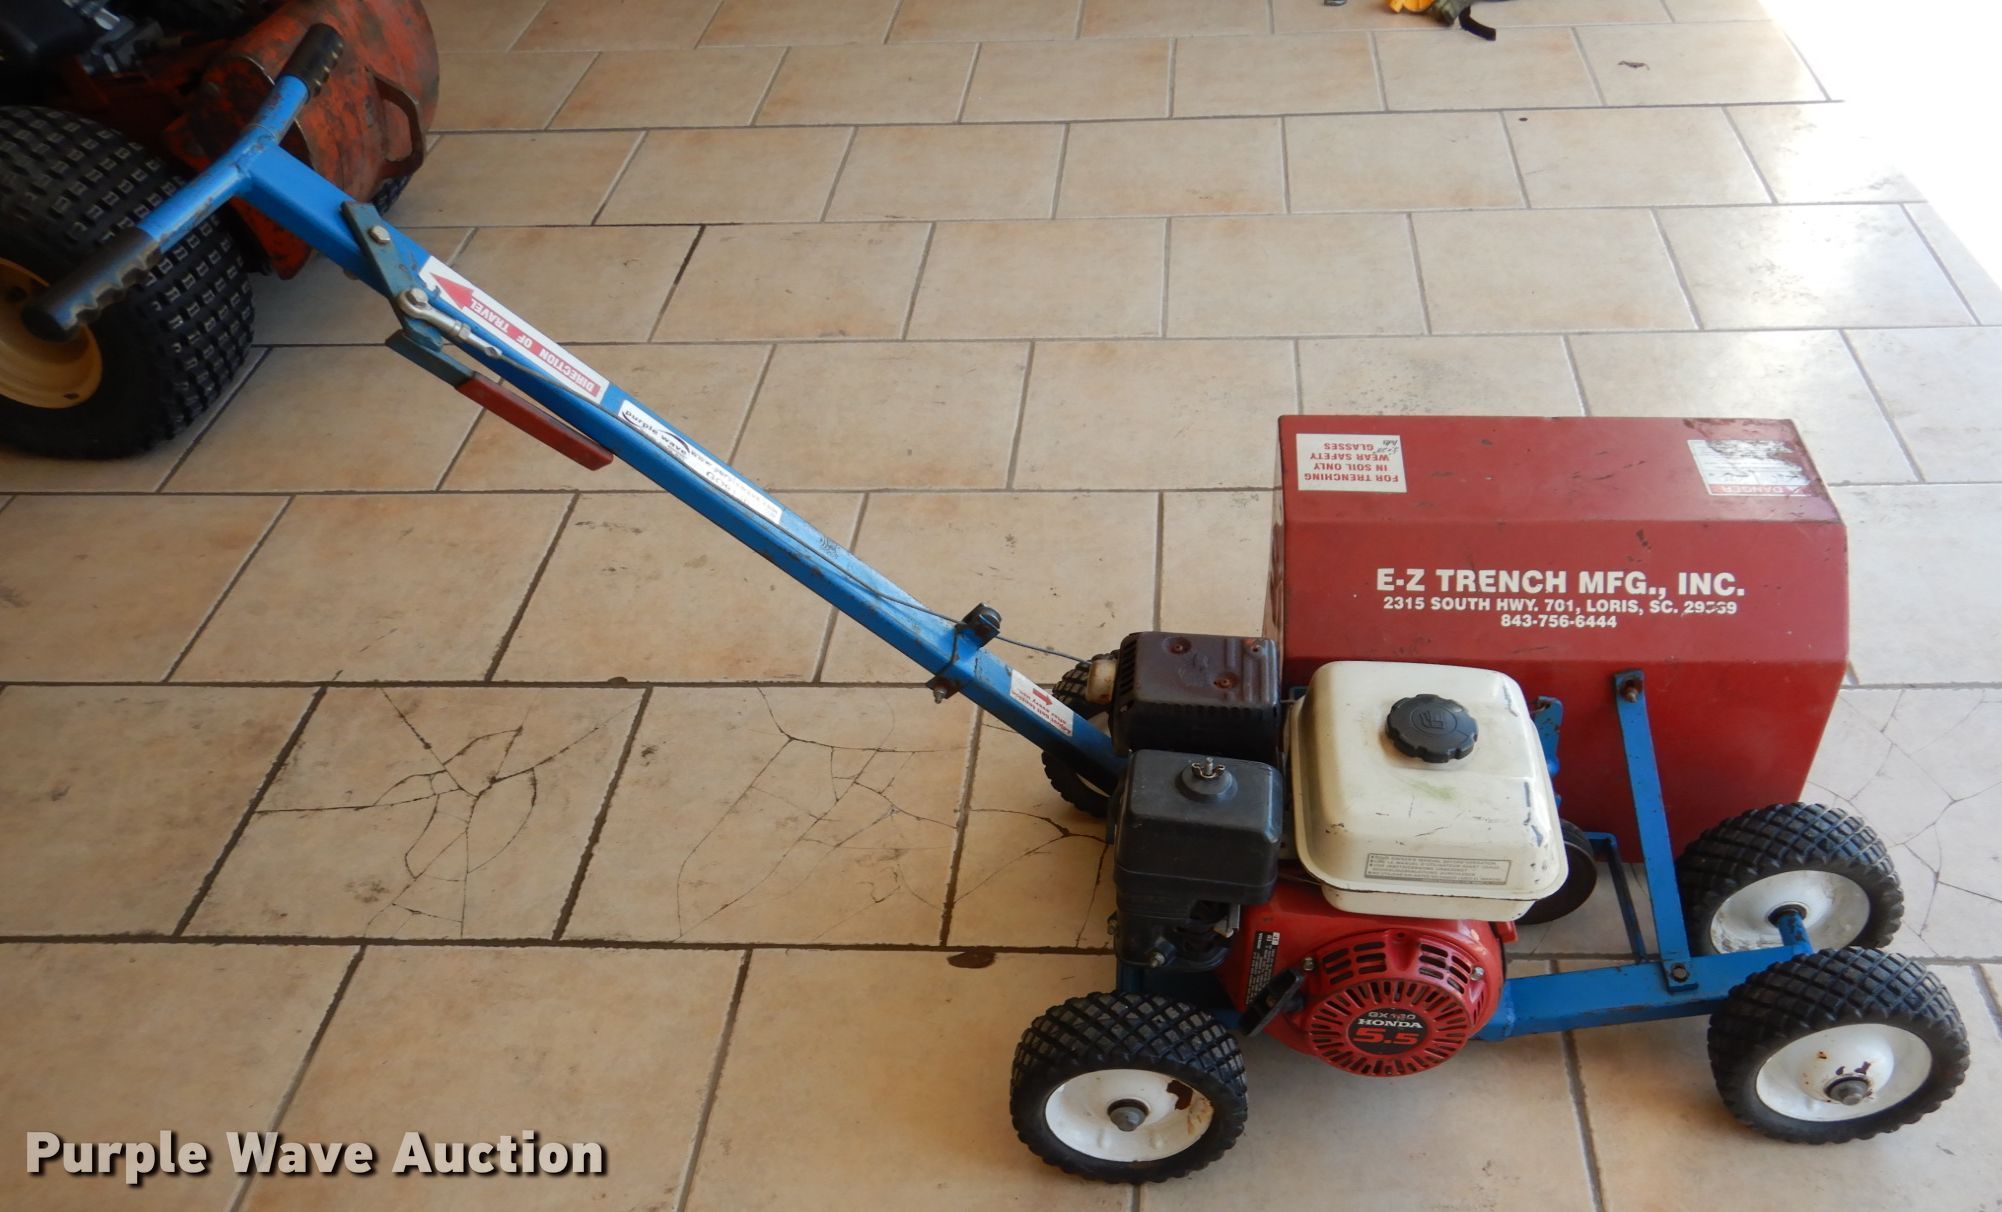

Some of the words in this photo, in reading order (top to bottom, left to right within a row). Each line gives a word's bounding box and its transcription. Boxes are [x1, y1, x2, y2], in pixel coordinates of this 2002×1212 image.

[469, 299, 509, 333] TRAVEL
[516, 334, 534, 349] OF
[540, 348, 596, 391] DIRECTION
[625, 410, 659, 435] purple
[661, 434, 687, 455] wave
[1324, 443, 1374, 451] GLASSES
[1310, 452, 1352, 460] SAFETY
[1356, 453, 1390, 461] WEAR
[1313, 462, 1342, 470] ONLY
[1346, 463, 1371, 471] SOIL
[1304, 473, 1372, 482] TRENCHING
[1727, 485, 1784, 494] DANGER
[1377, 568, 1425, 591] E-Z
[1436, 569, 1567, 594] TRENCH
[1579, 571, 1667, 600] MFG.,
[1678, 572, 1745, 596] INC.
[1383, 597, 1425, 610] 2315
[1431, 597, 1490, 611] SOUTH
[1496, 599, 1539, 612] HWY.
[1544, 599, 1581, 615] 701,
[1586, 600, 1644, 616] LORIS,
[1649, 600, 1678, 613] SC.
[1501, 615, 1617, 628] 843-756-6444
[1358, 1018, 1424, 1029] HONDA
[1353, 1027, 1420, 1046] 5.5
